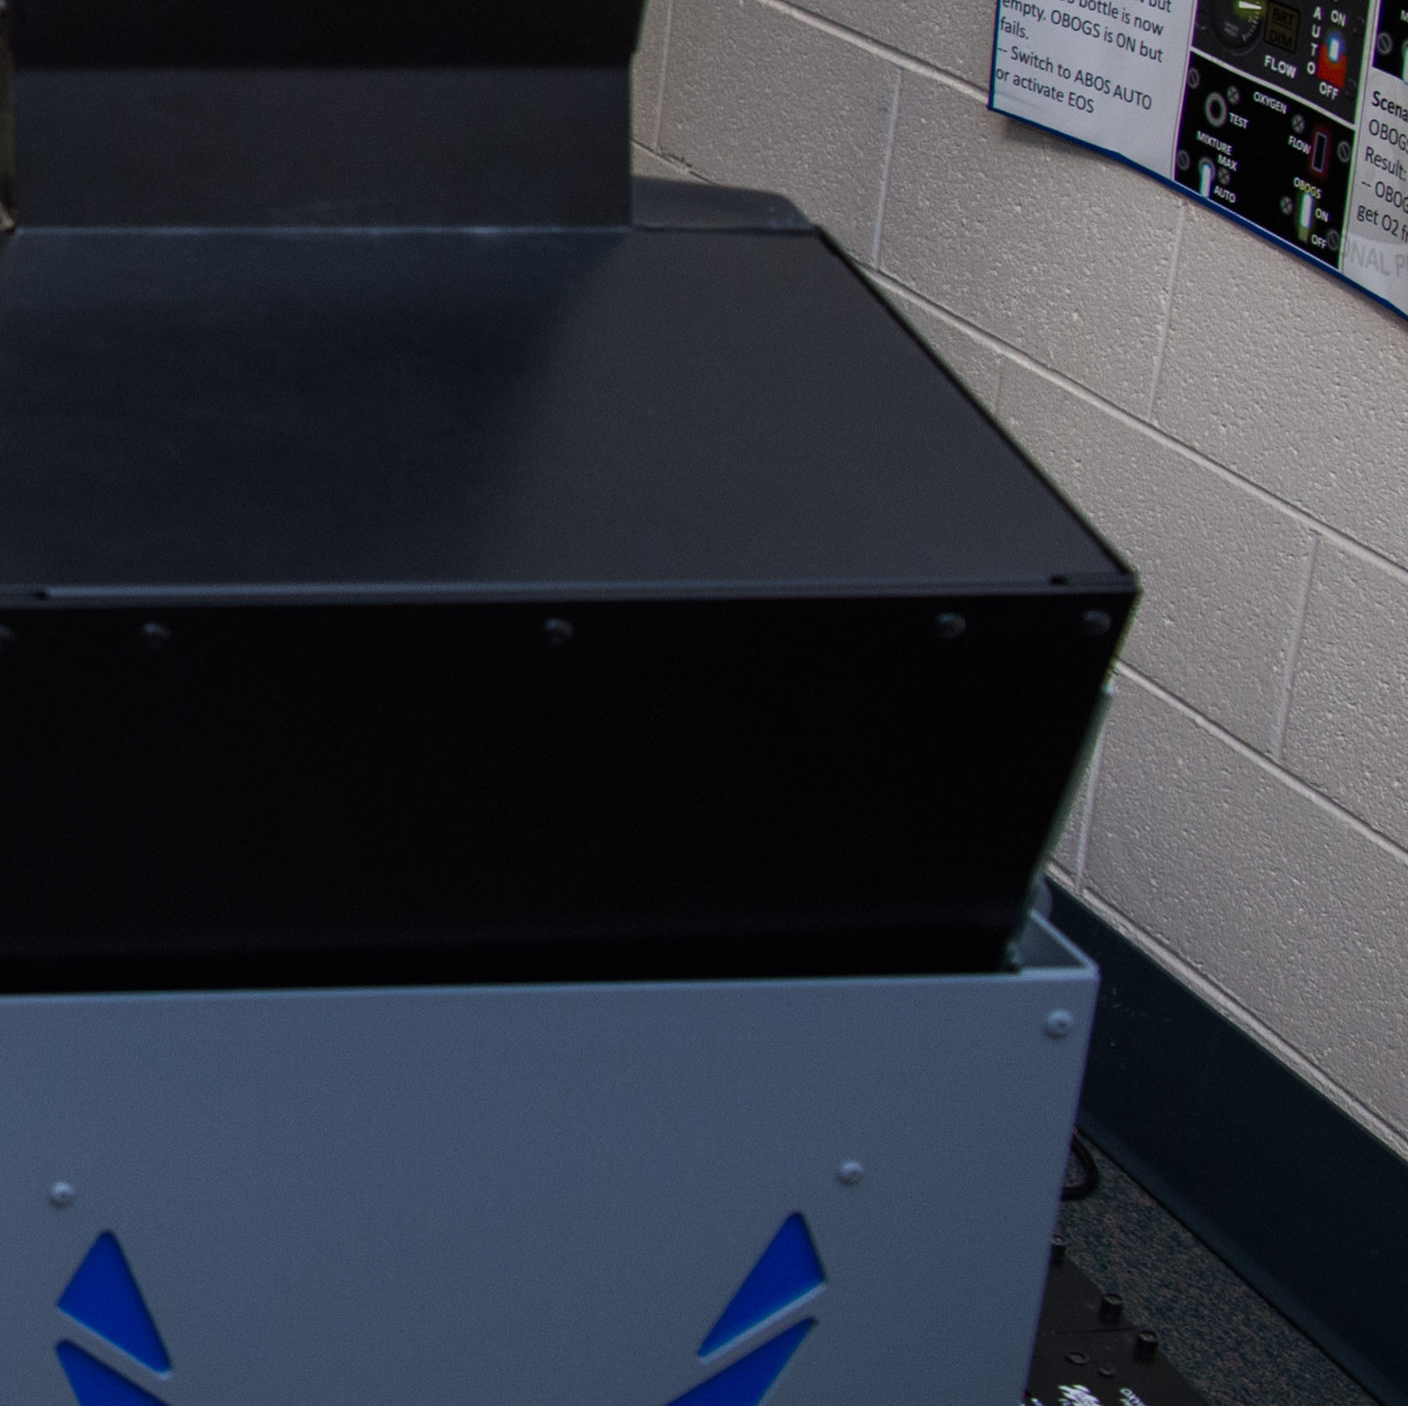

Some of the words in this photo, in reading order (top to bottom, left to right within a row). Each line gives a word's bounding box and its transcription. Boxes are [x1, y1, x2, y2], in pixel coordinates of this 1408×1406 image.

[1000, 17, 1029, 39] fails.
[1051, 9, 1101, 38] OBOGS
[1104, 27, 1113, 43] is
[1116, 33, 1136, 52] ON
[1139, 40, 1163, 63] but
[1121, 8, 1131, 25] is
[1134, 16, 1164, 35] now
[995, 68, 1009, 81] or
[1013, 74, 1065, 103] activate
[1068, 93, 1095, 113] EOS
[1011, 46, 1054, 73] Switch
[1058, 64, 1071, 79] to
[1074, 70, 1111, 95] ABOS
[1113, 85, 1152, 110] AUTO
